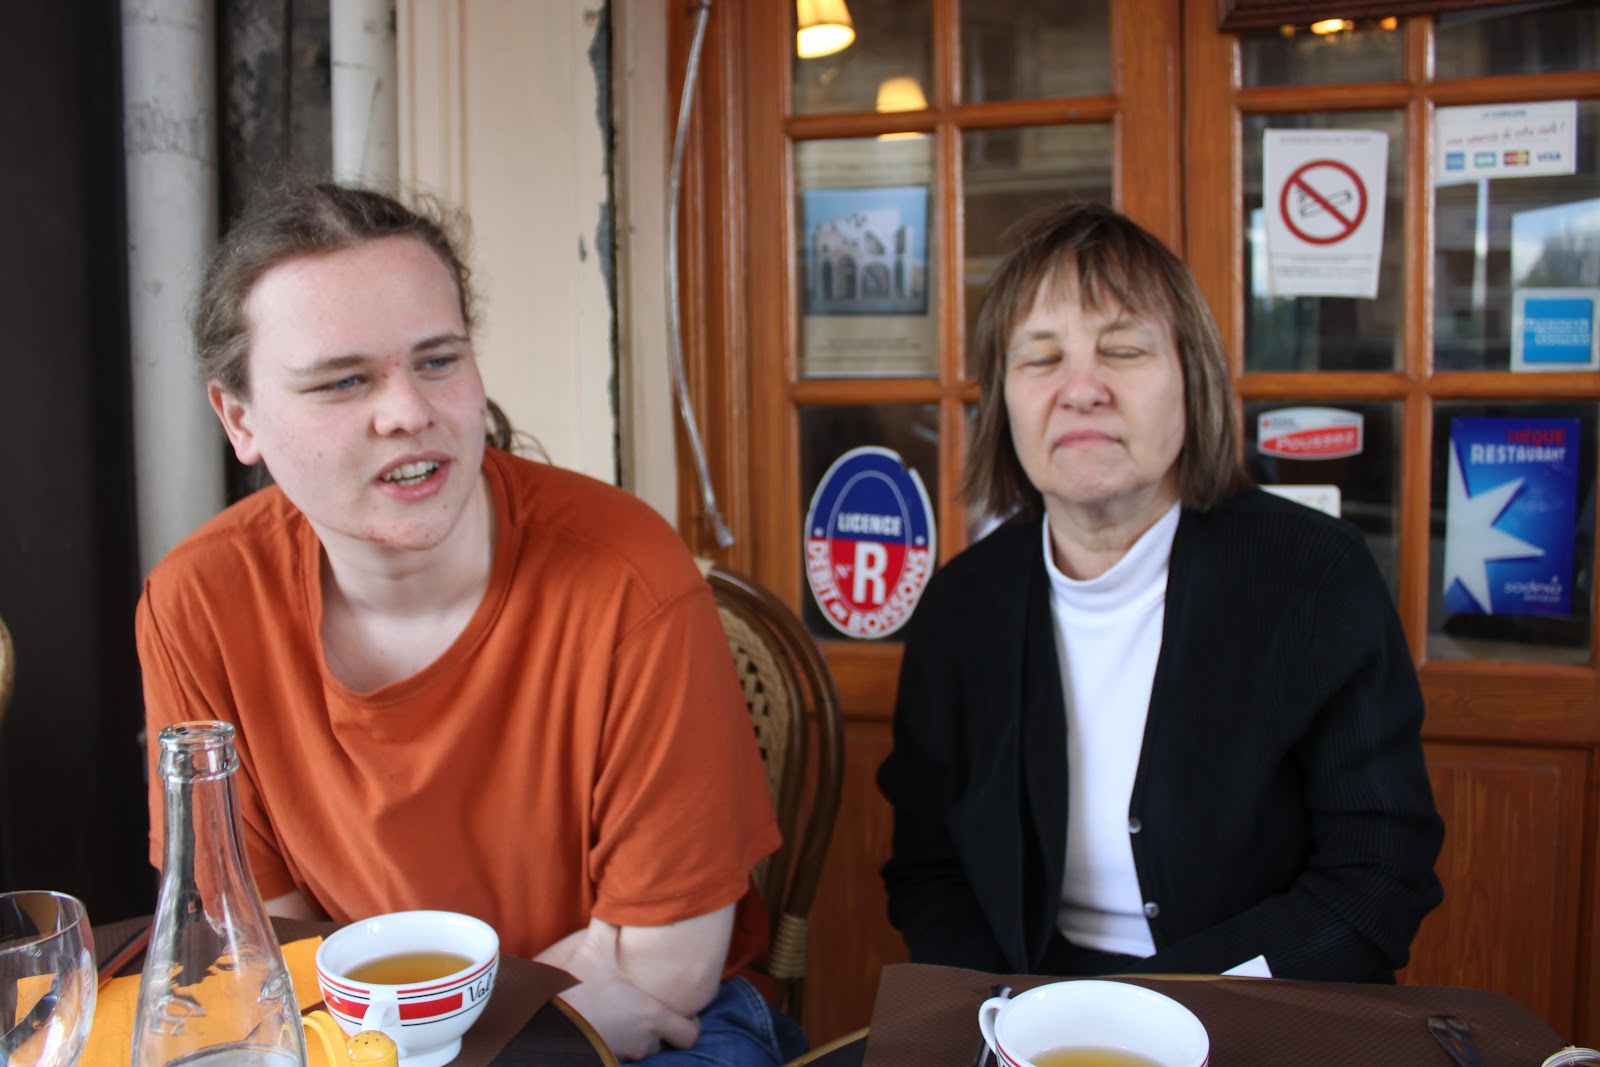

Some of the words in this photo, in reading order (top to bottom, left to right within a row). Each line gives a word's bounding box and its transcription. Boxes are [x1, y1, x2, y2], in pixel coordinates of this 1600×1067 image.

[1470, 443, 1567, 465] RESTAURANT
[837, 512, 903, 536] LICENCE
[853, 541, 888, 605] R
[848, 549, 930, 635] BOISSONS
[467, 972, 492, 1002] Val
